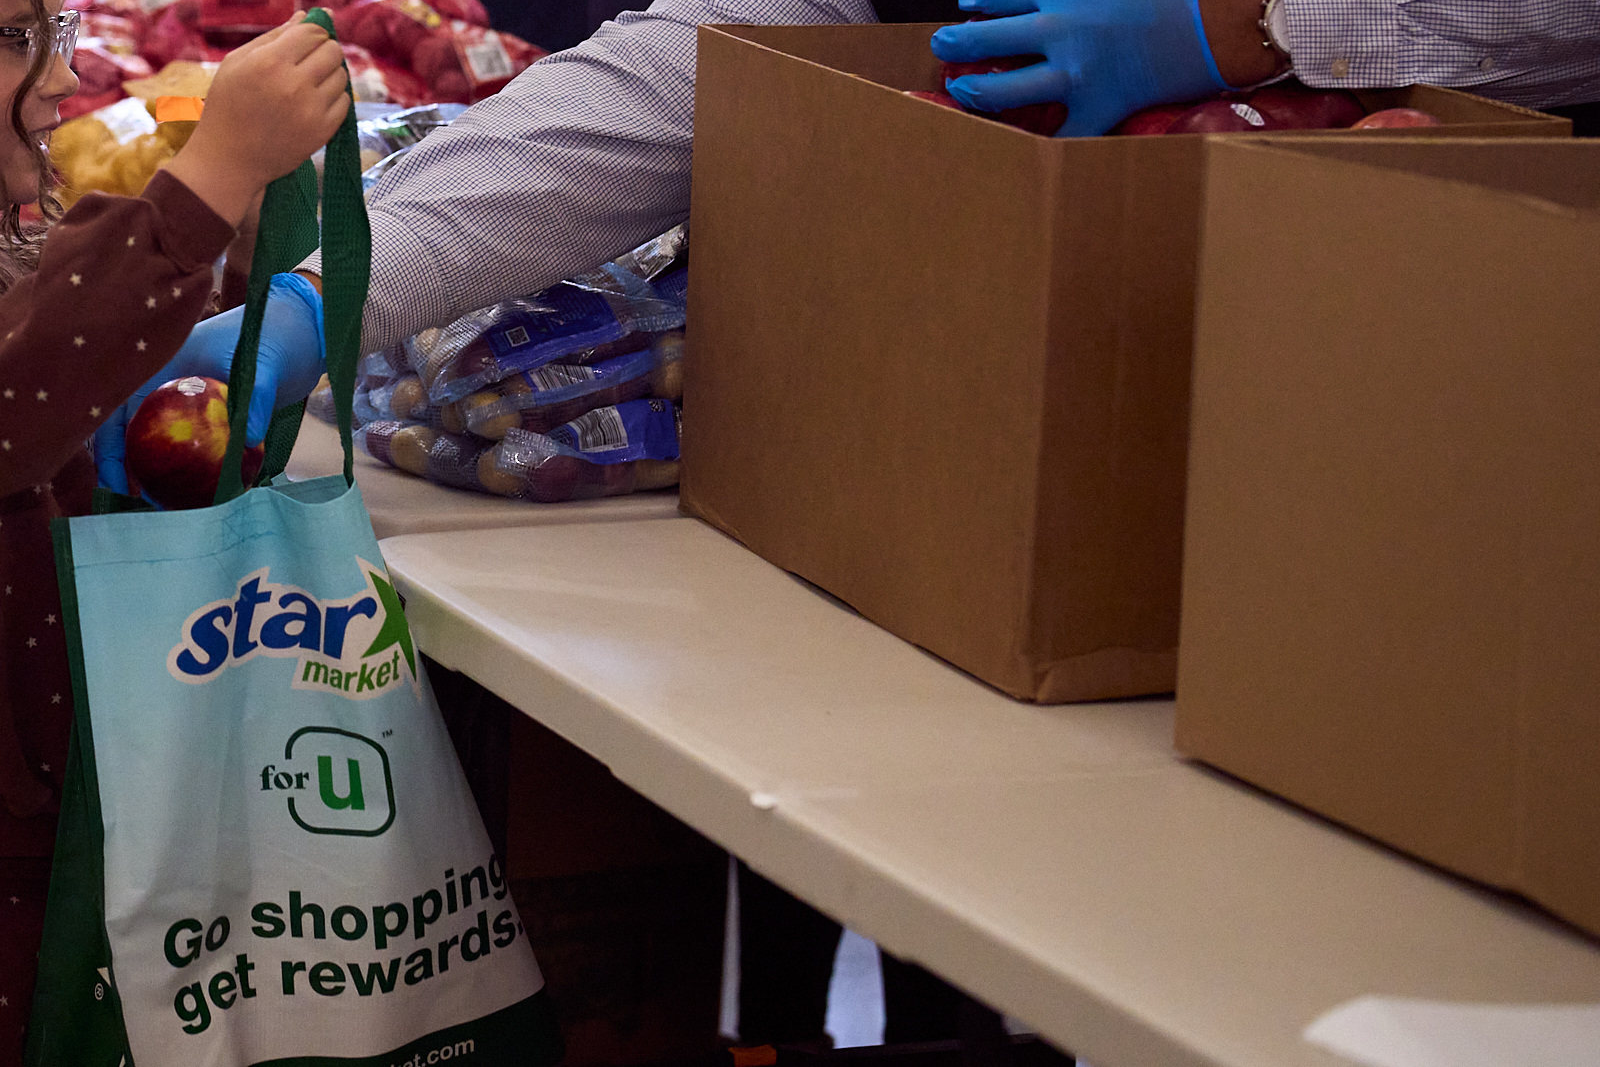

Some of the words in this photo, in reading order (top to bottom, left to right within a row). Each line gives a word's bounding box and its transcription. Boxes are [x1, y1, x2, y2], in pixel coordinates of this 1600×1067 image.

[176, 575, 378, 677] star
[302, 653, 400, 692] market
[260, 764, 310, 791] for
[164, 918, 231, 968] Go
[174, 954, 257, 1035] get
